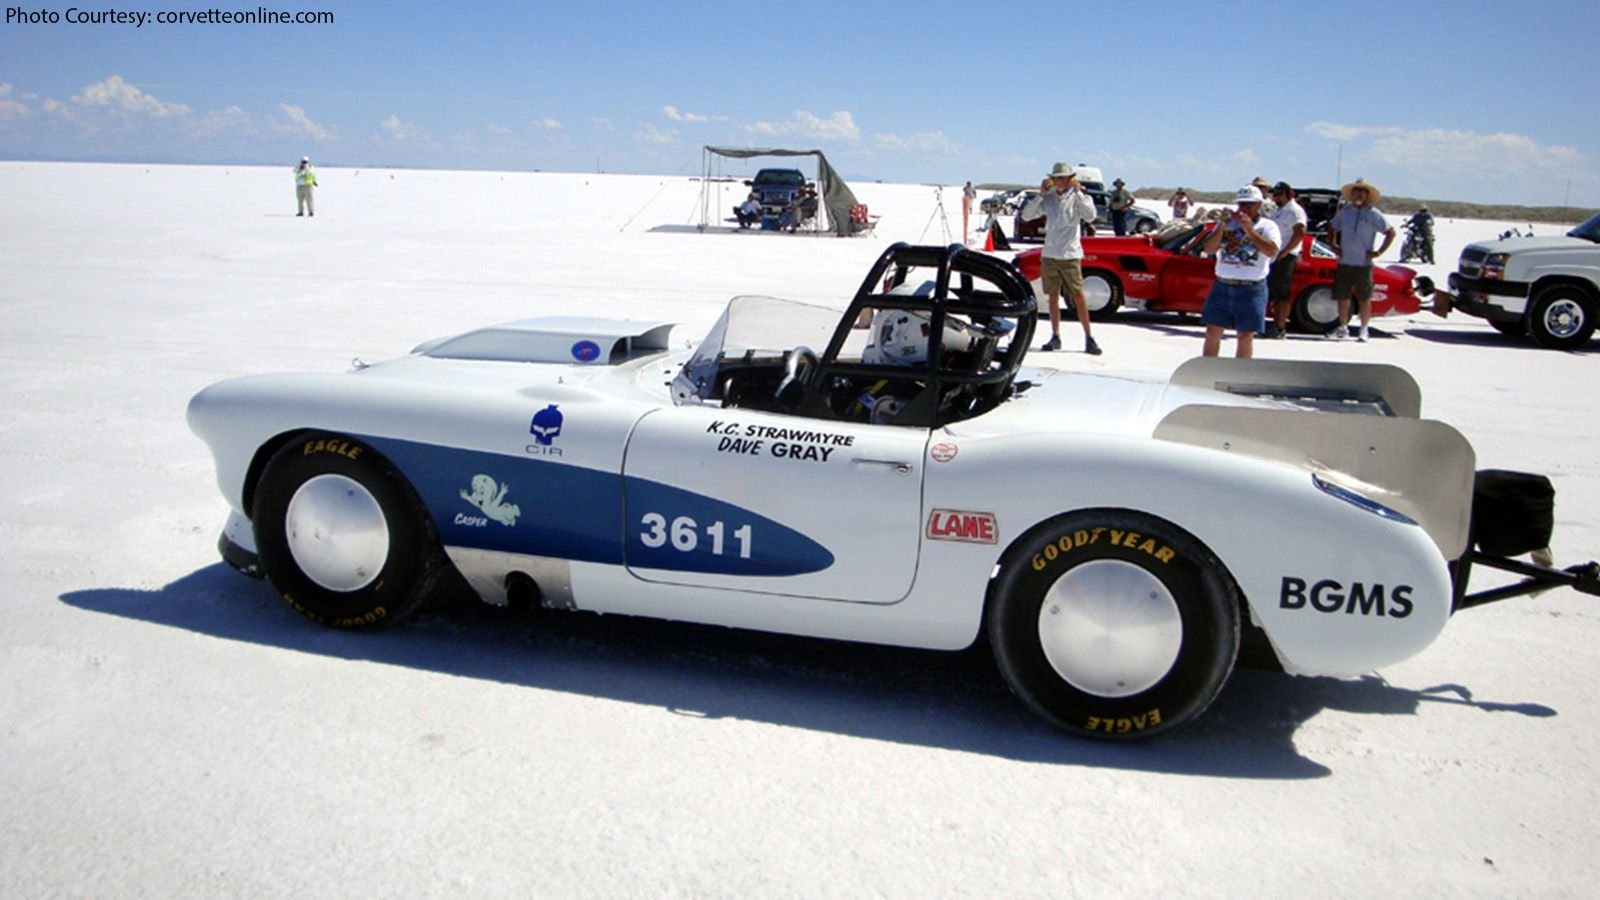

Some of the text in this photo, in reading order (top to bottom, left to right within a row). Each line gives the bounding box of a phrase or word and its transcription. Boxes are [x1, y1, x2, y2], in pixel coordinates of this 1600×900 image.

[706, 420, 855, 447] K.C. STRAWMYRE
[303, 440, 363, 460] EAGLE
[717, 436, 834, 462] DAVE GRAY
[640, 512, 752, 559] 3611
[931, 513, 993, 539] LANE
[1032, 527, 1176, 571] GOODYEAR
[1279, 576, 1415, 619] BGMS
[1086, 708, 1163, 733] EAGLE
